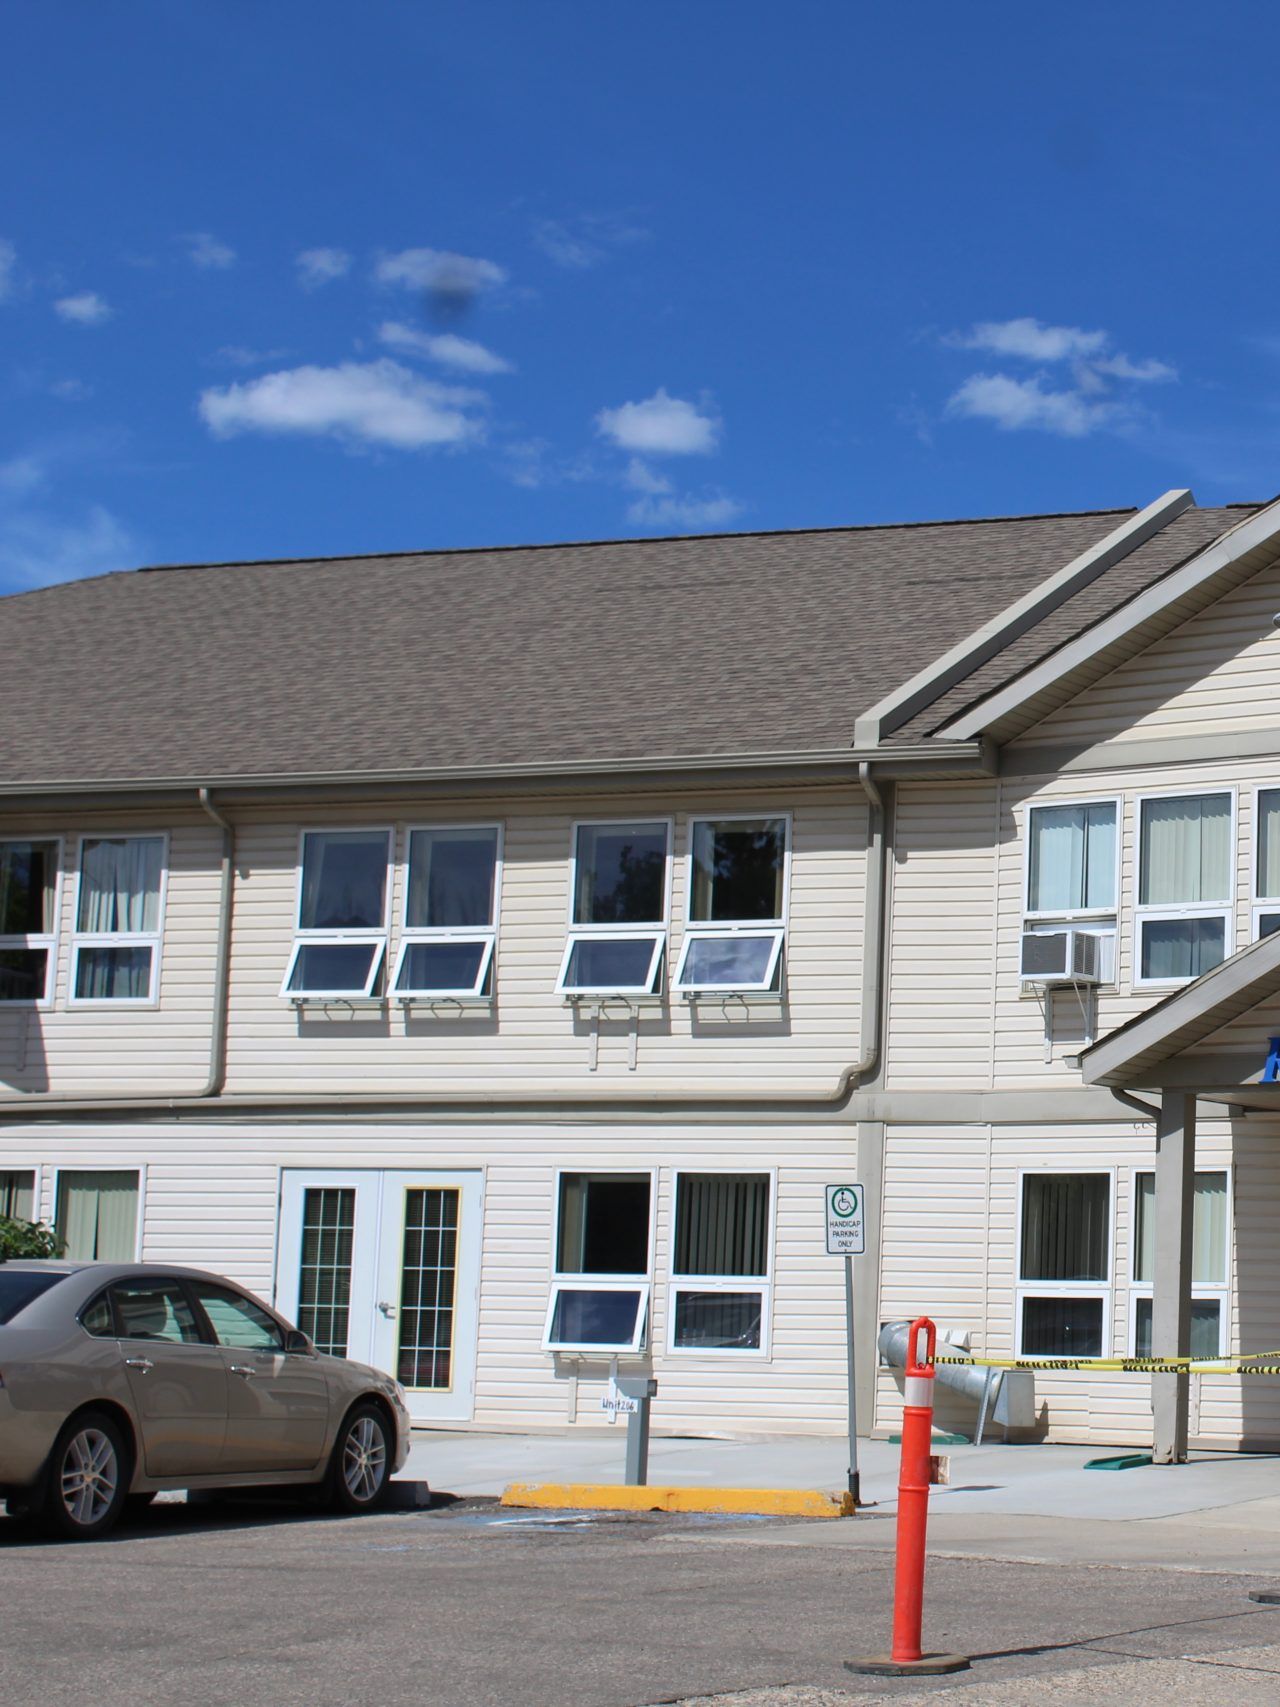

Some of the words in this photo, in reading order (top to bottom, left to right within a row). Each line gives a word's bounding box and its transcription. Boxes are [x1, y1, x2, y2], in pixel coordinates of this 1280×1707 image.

[829, 1220, 861, 1228] HANDICAP
[832, 1230, 859, 1238] PARKING
[838, 1240, 853, 1248] ONLY
